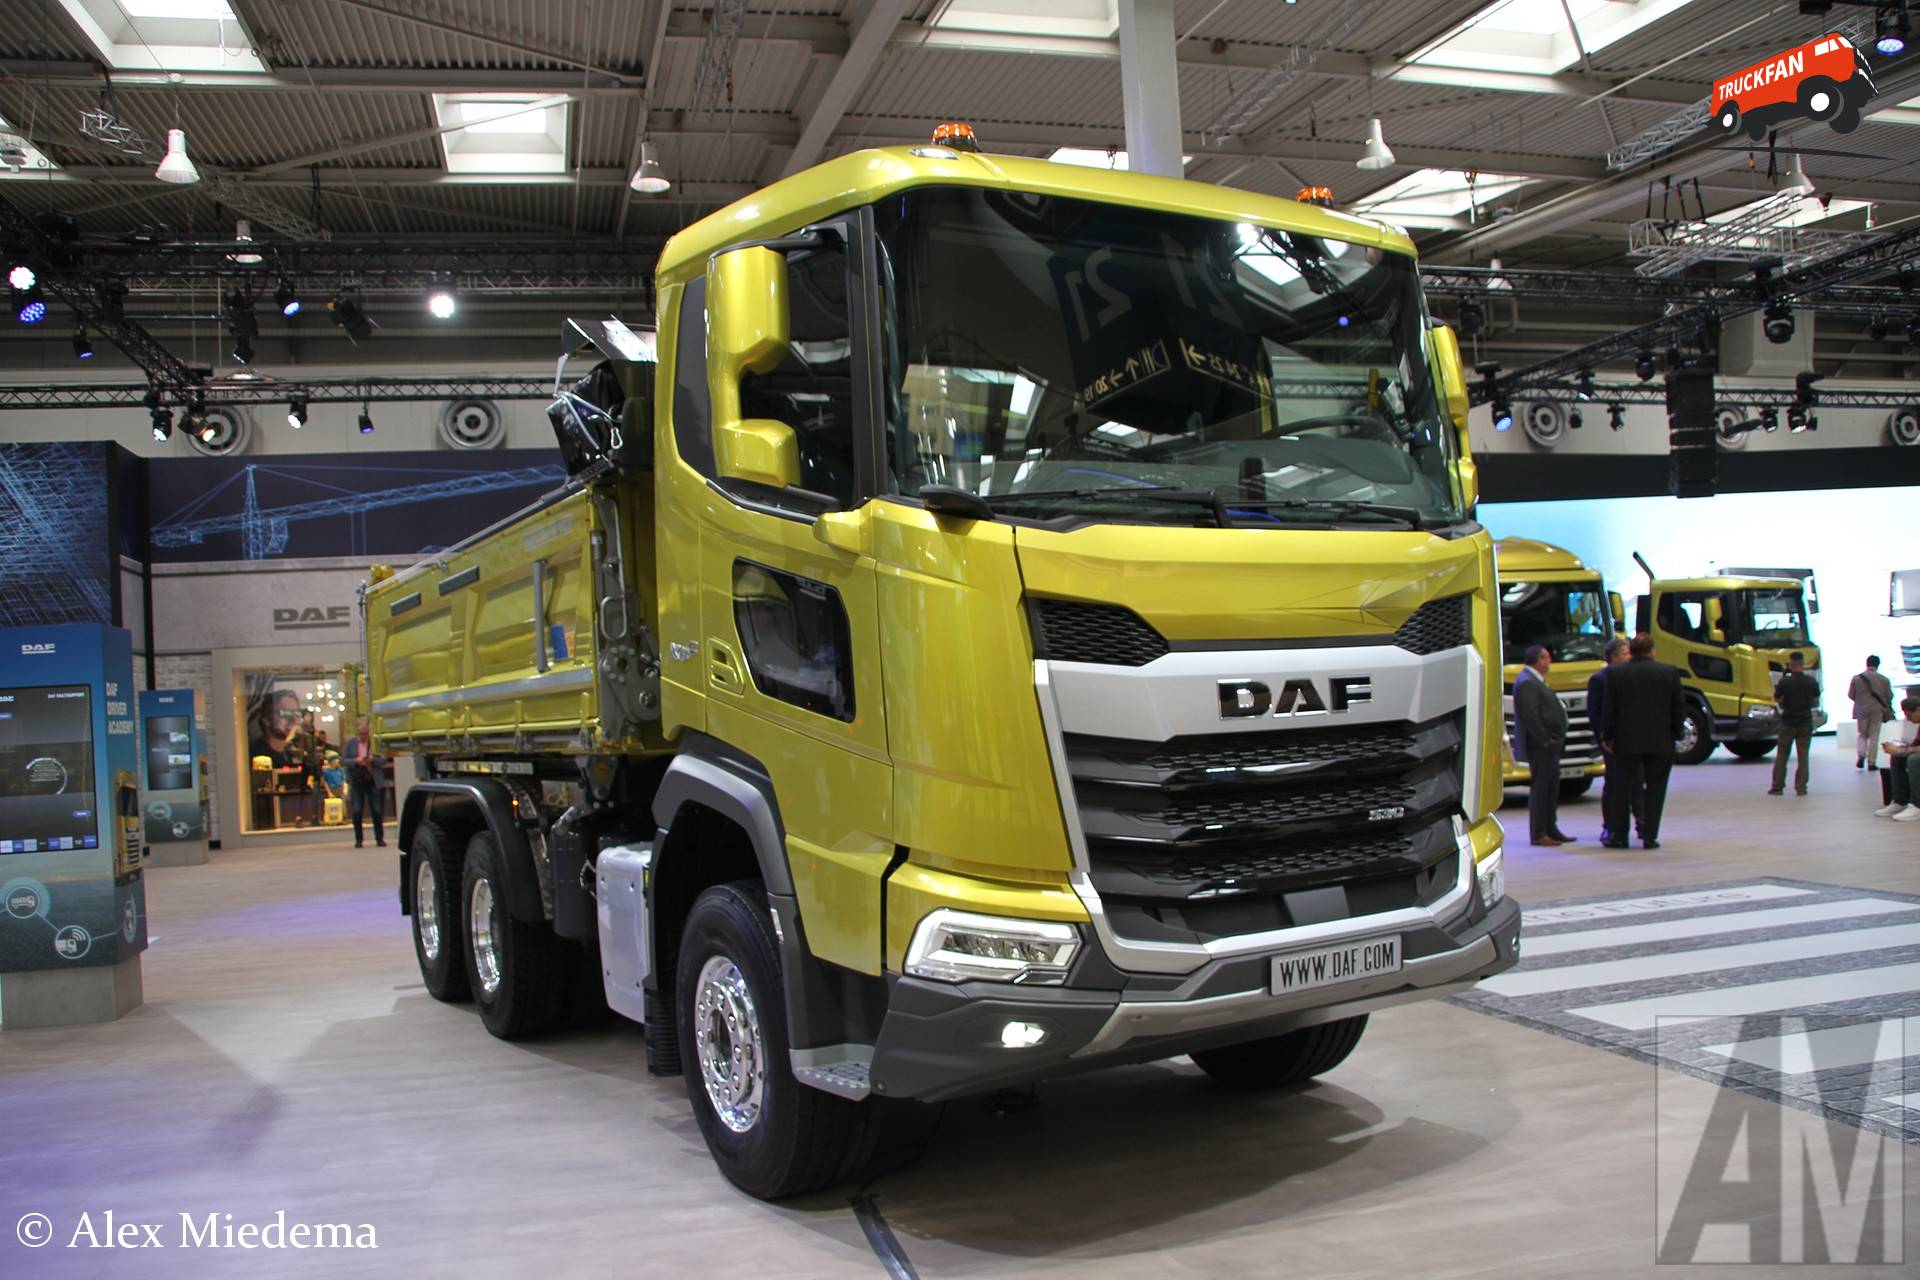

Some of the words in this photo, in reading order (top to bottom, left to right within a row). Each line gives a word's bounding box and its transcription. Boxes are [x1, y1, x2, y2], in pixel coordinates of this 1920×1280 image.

[273, 606, 350, 623] DAF
[21, 643, 56, 652] DAF
[1217, 674, 1373, 721] DAF
[1280, 940, 1395, 988] WWW.DAF.COM
